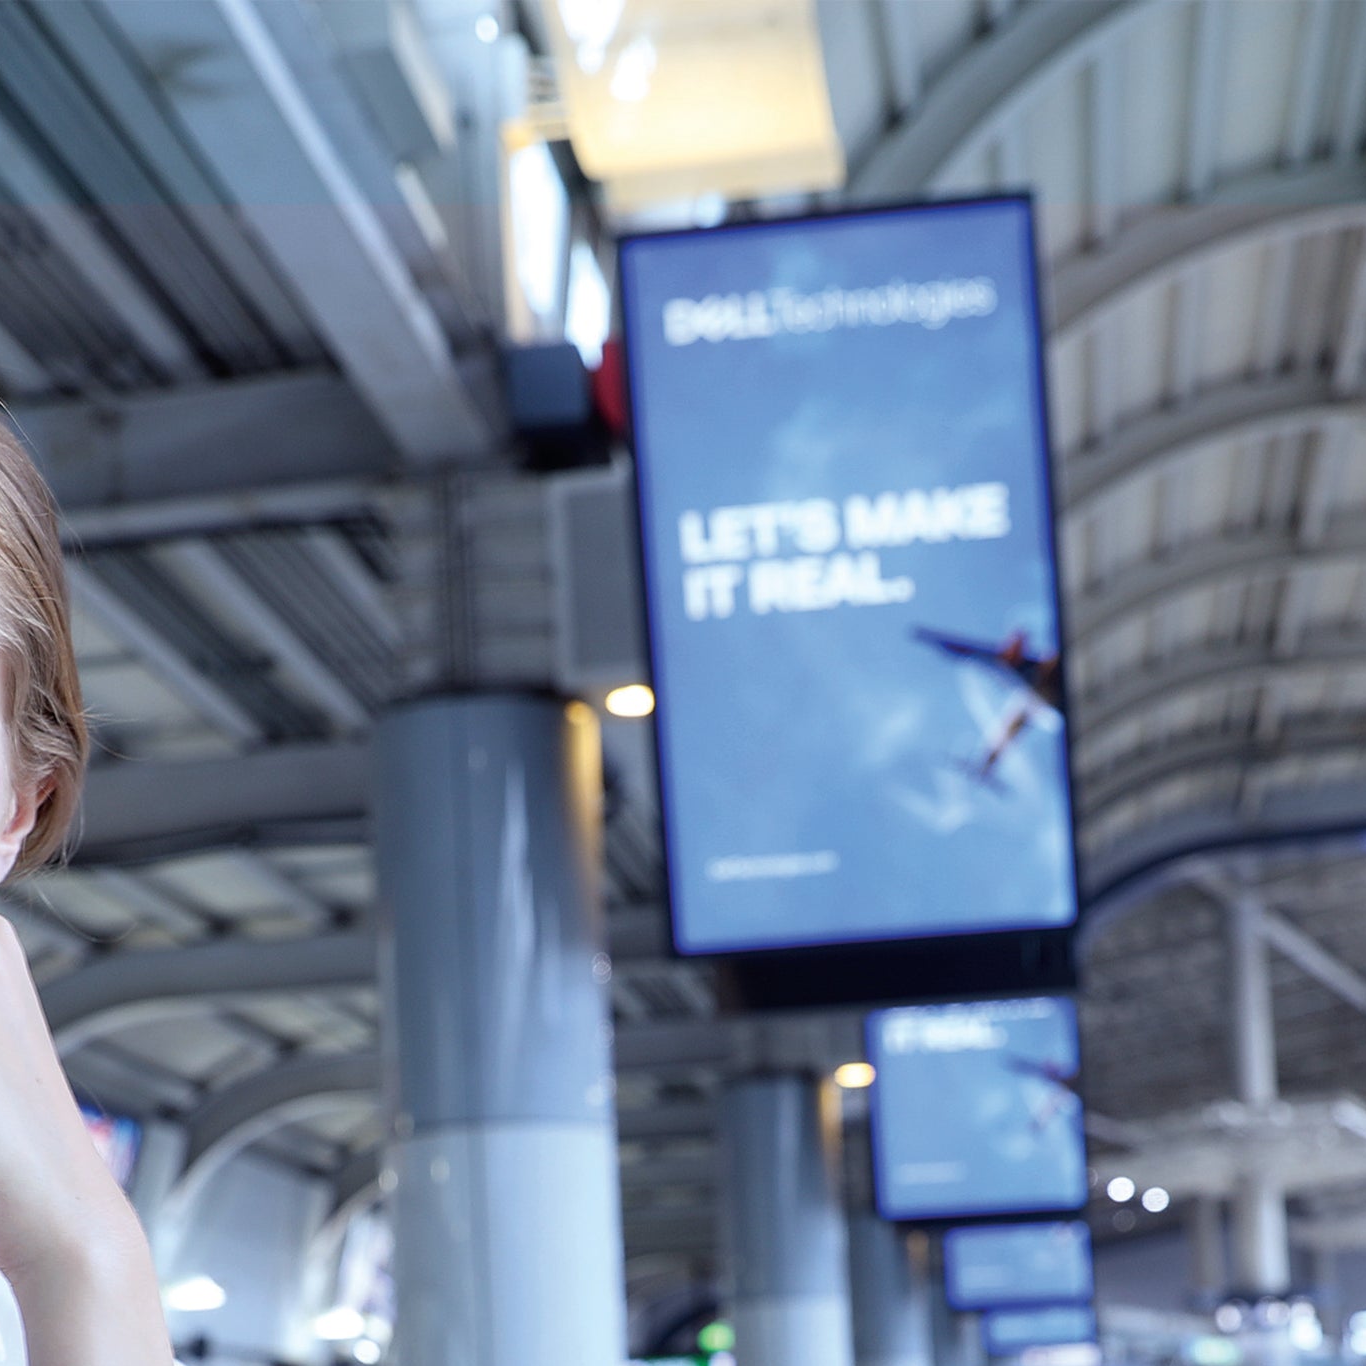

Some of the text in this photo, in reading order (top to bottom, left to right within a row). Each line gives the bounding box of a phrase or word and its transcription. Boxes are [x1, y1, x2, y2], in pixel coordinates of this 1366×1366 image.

[680, 483, 1009, 563] LET'S MAKE
[684, 551, 914, 620] IT REAL.
